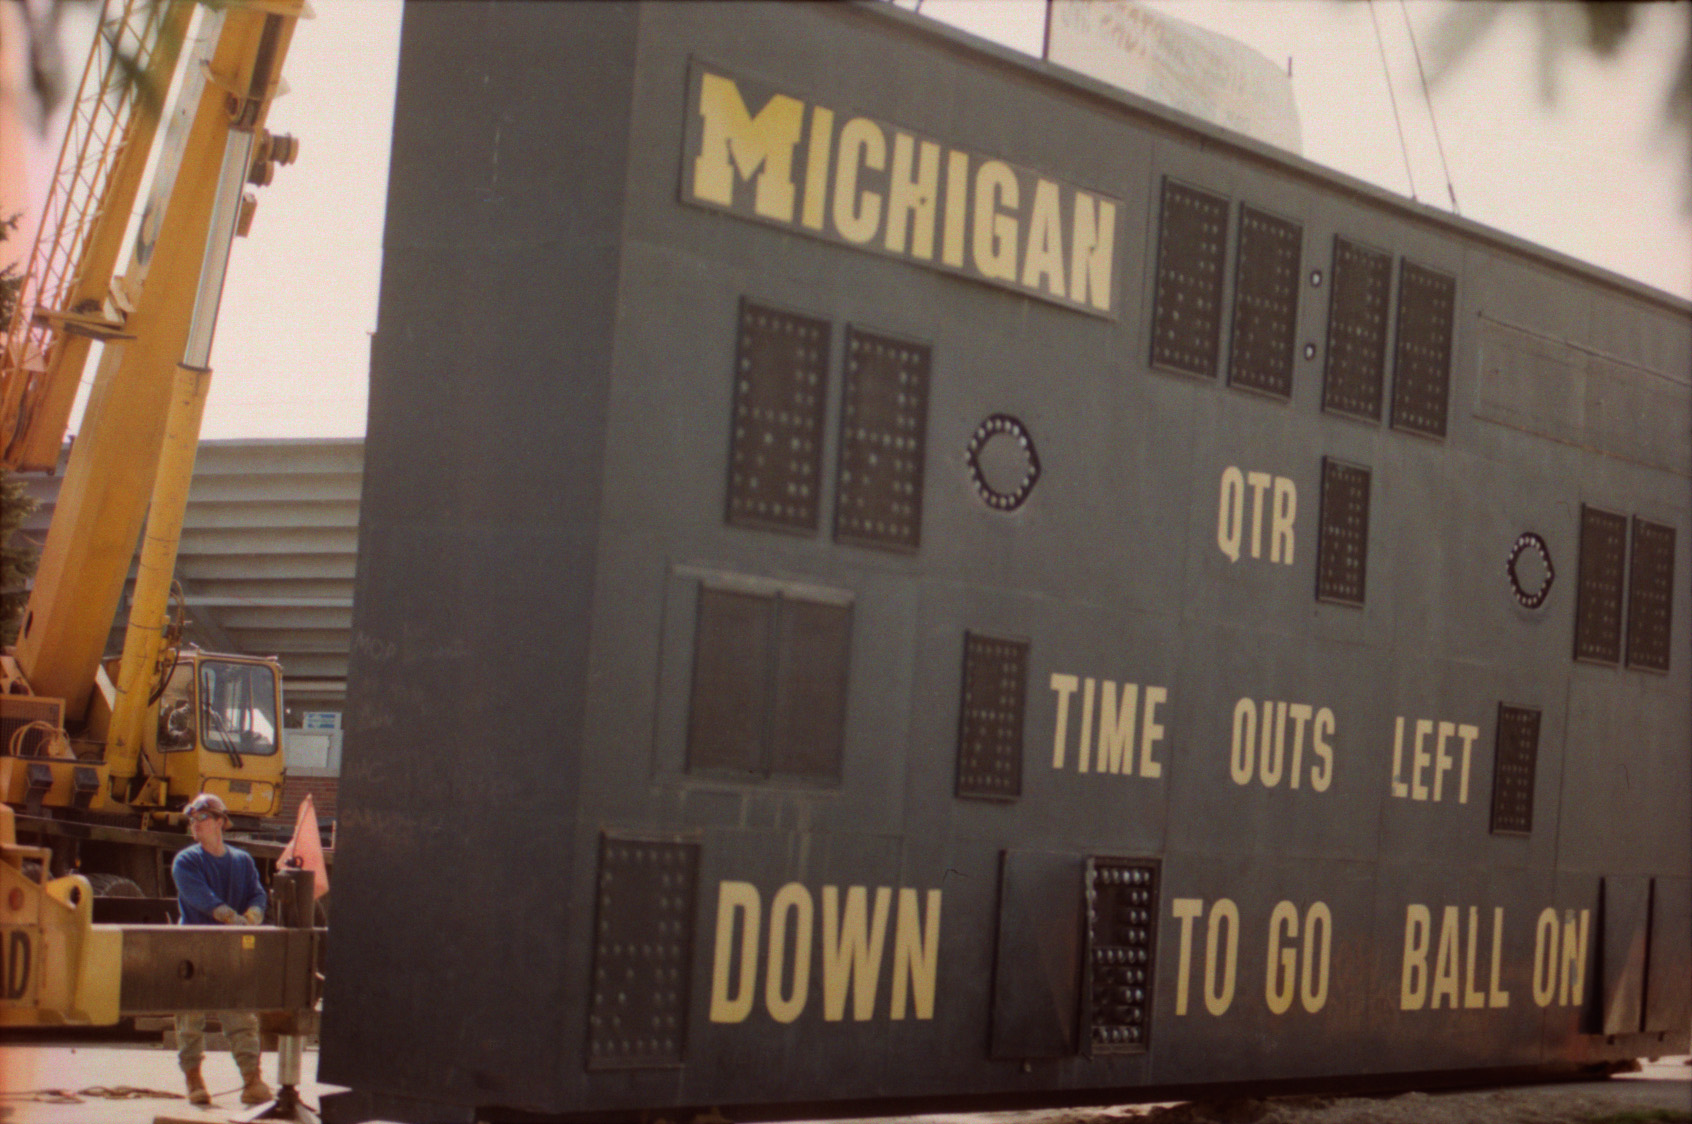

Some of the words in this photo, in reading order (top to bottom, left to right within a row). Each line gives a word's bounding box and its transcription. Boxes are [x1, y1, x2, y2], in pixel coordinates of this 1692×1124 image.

[692, 72, 1117, 313] MICHIGAN
[1217, 465, 1298, 566] QTR
[1049, 672, 1169, 779] TIME
[1230, 696, 1337, 793] OUTS
[1390, 715, 1480, 805] LEFT
[709, 880, 943, 1024] DOWN
[1171, 897, 1240, 1017] TO
[1265, 900, 1333, 1015] GO
[1400, 904, 1510, 1011] BALL
[1533, 907, 1590, 1008] ON
